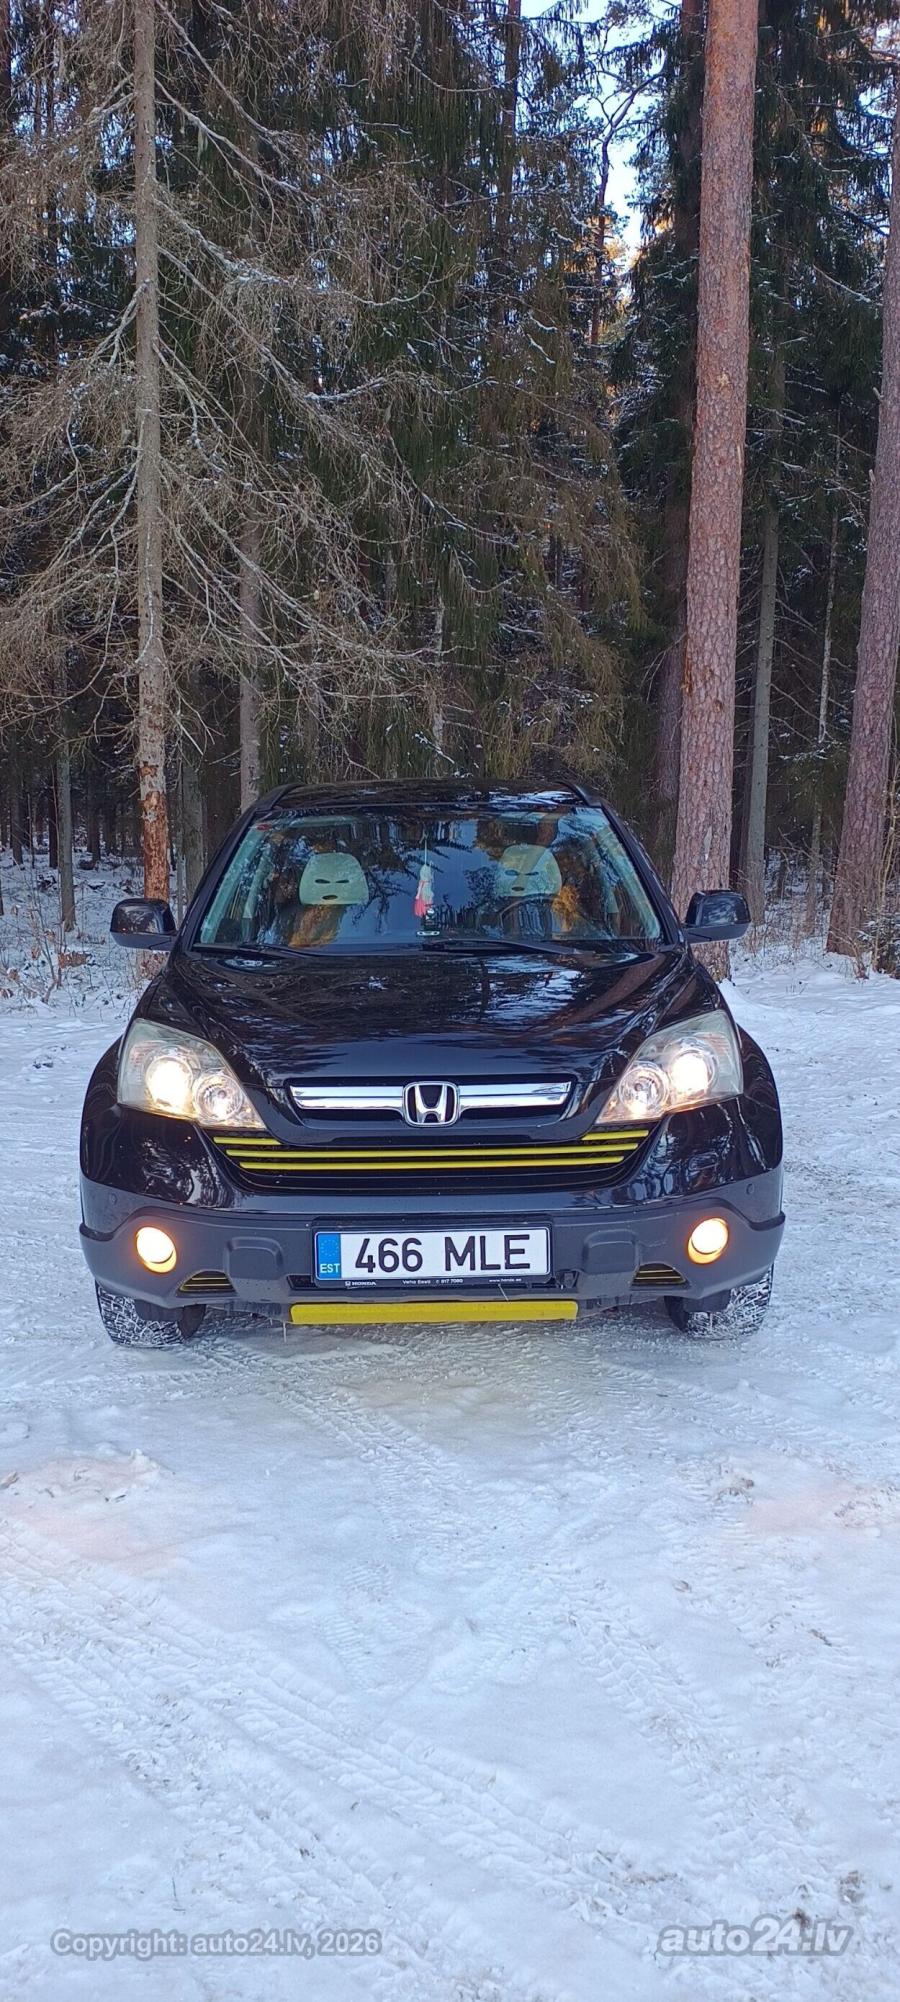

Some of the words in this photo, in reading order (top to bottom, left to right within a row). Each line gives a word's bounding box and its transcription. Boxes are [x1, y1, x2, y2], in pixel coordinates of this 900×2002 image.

[354, 1237, 423, 1273] 466
[444, 1234, 531, 1271] MLE
[320, 1263, 340, 1274] EST
